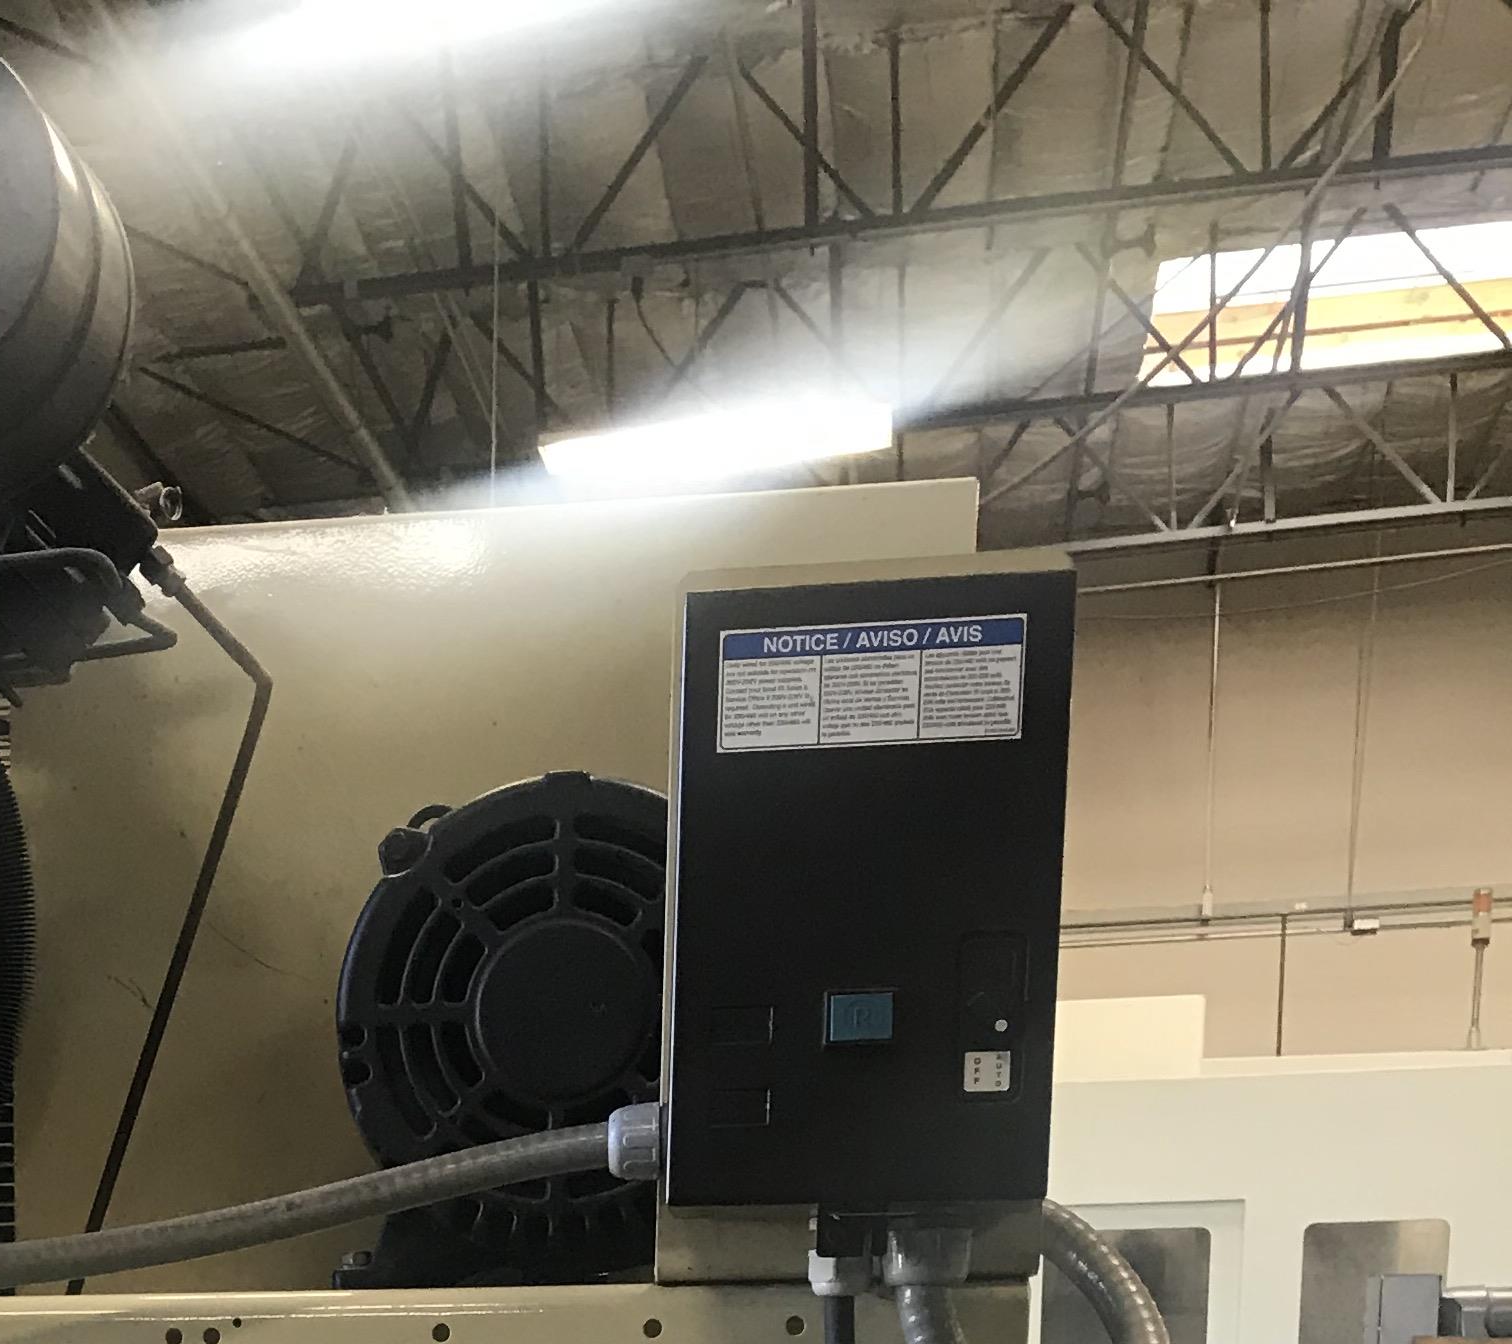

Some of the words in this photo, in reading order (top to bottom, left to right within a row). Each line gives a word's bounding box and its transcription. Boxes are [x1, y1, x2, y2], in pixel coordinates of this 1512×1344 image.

[763, 629, 838, 653] NOTICE
[856, 627, 919, 649] AVISO
[936, 624, 983, 645] AVIS
[974, 1057, 982, 1085] OFF
